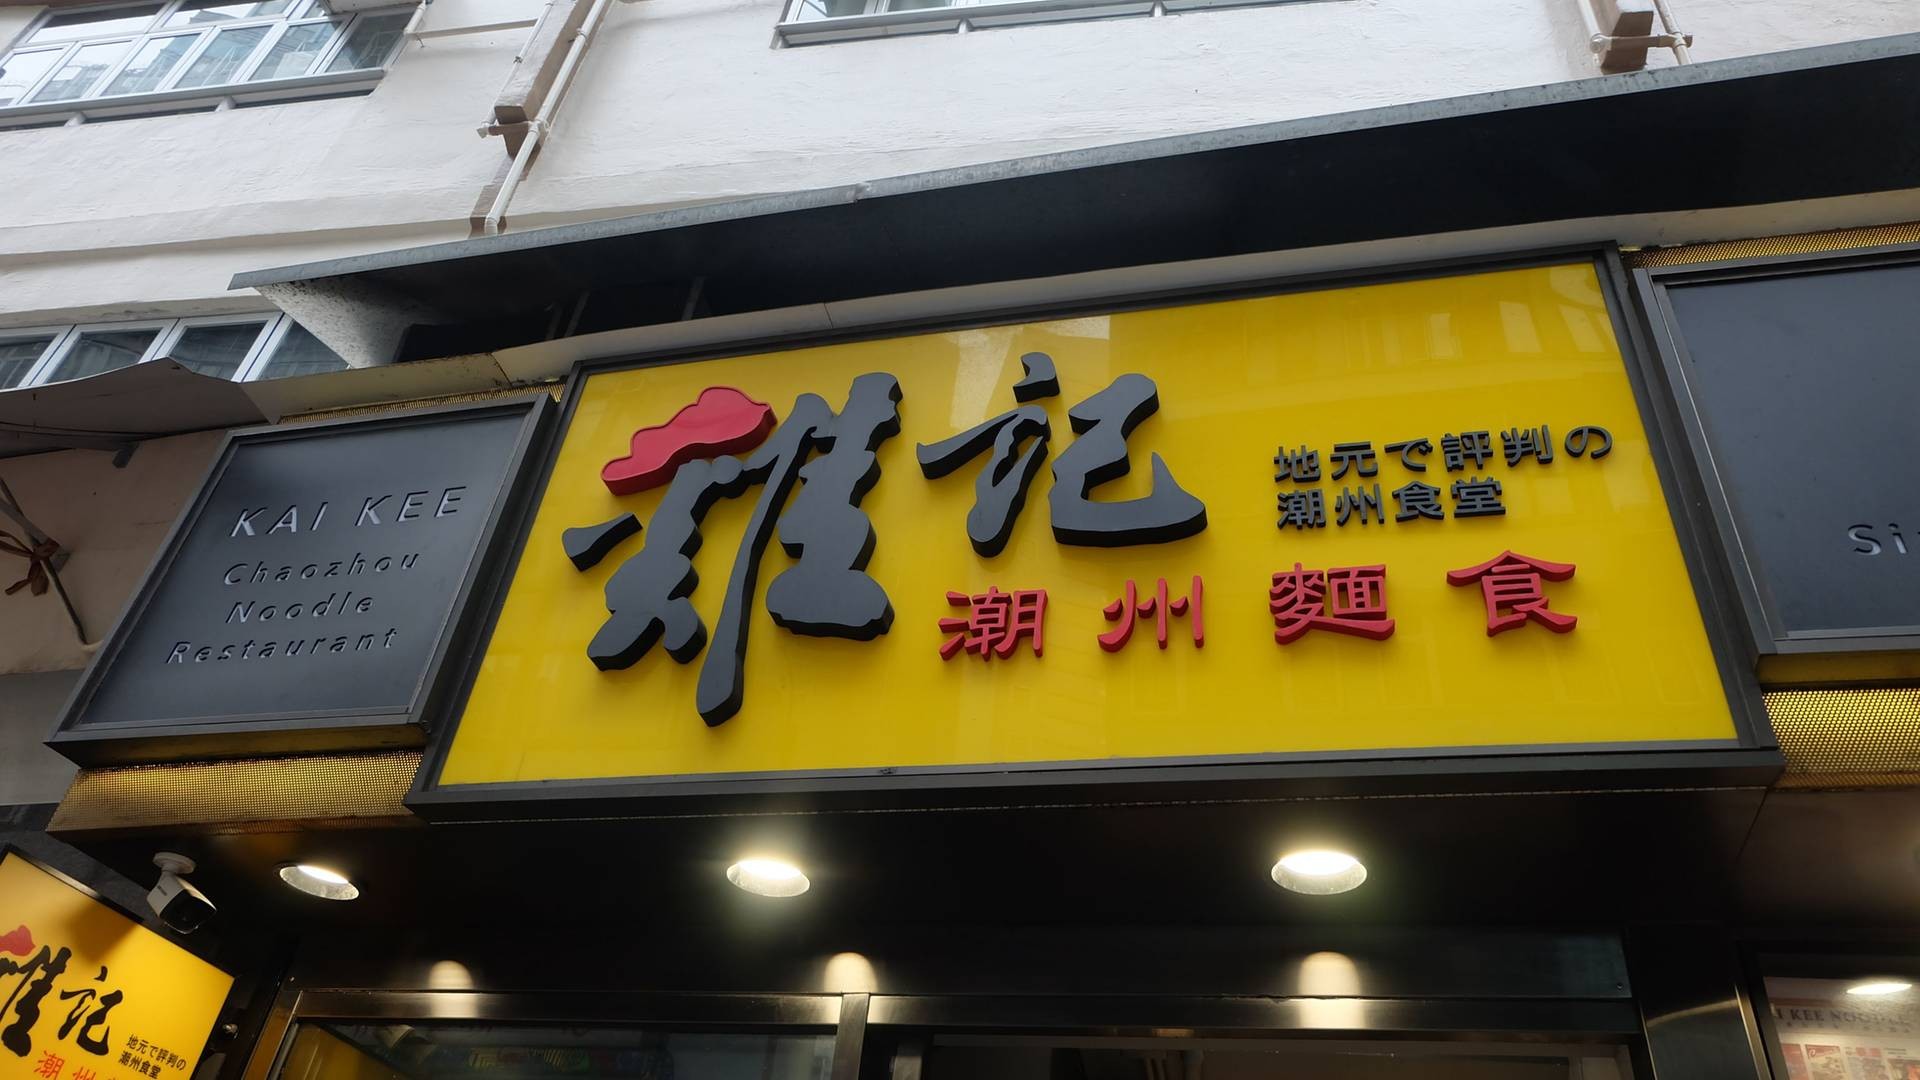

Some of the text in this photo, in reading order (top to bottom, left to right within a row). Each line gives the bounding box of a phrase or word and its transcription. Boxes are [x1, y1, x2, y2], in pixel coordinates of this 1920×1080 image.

[1273, 424, 1614, 483] 地元で評判の
[229, 485, 468, 537] KAI KEE
[1276, 476, 1506, 530] 潮州食堂
[1847, 522, 1920, 556] Si
[223, 550, 419, 586] Chaozhou
[226, 591, 375, 625] Noodle
[937, 549, 1577, 662] 潮州麵食
[166, 626, 399, 665] Restaurant
[1789, 1008, 1825, 1022] KEE
[117, 1049, 161, 1080] 潮州食堂
[126, 1033, 187, 1071] 地元で評判の
